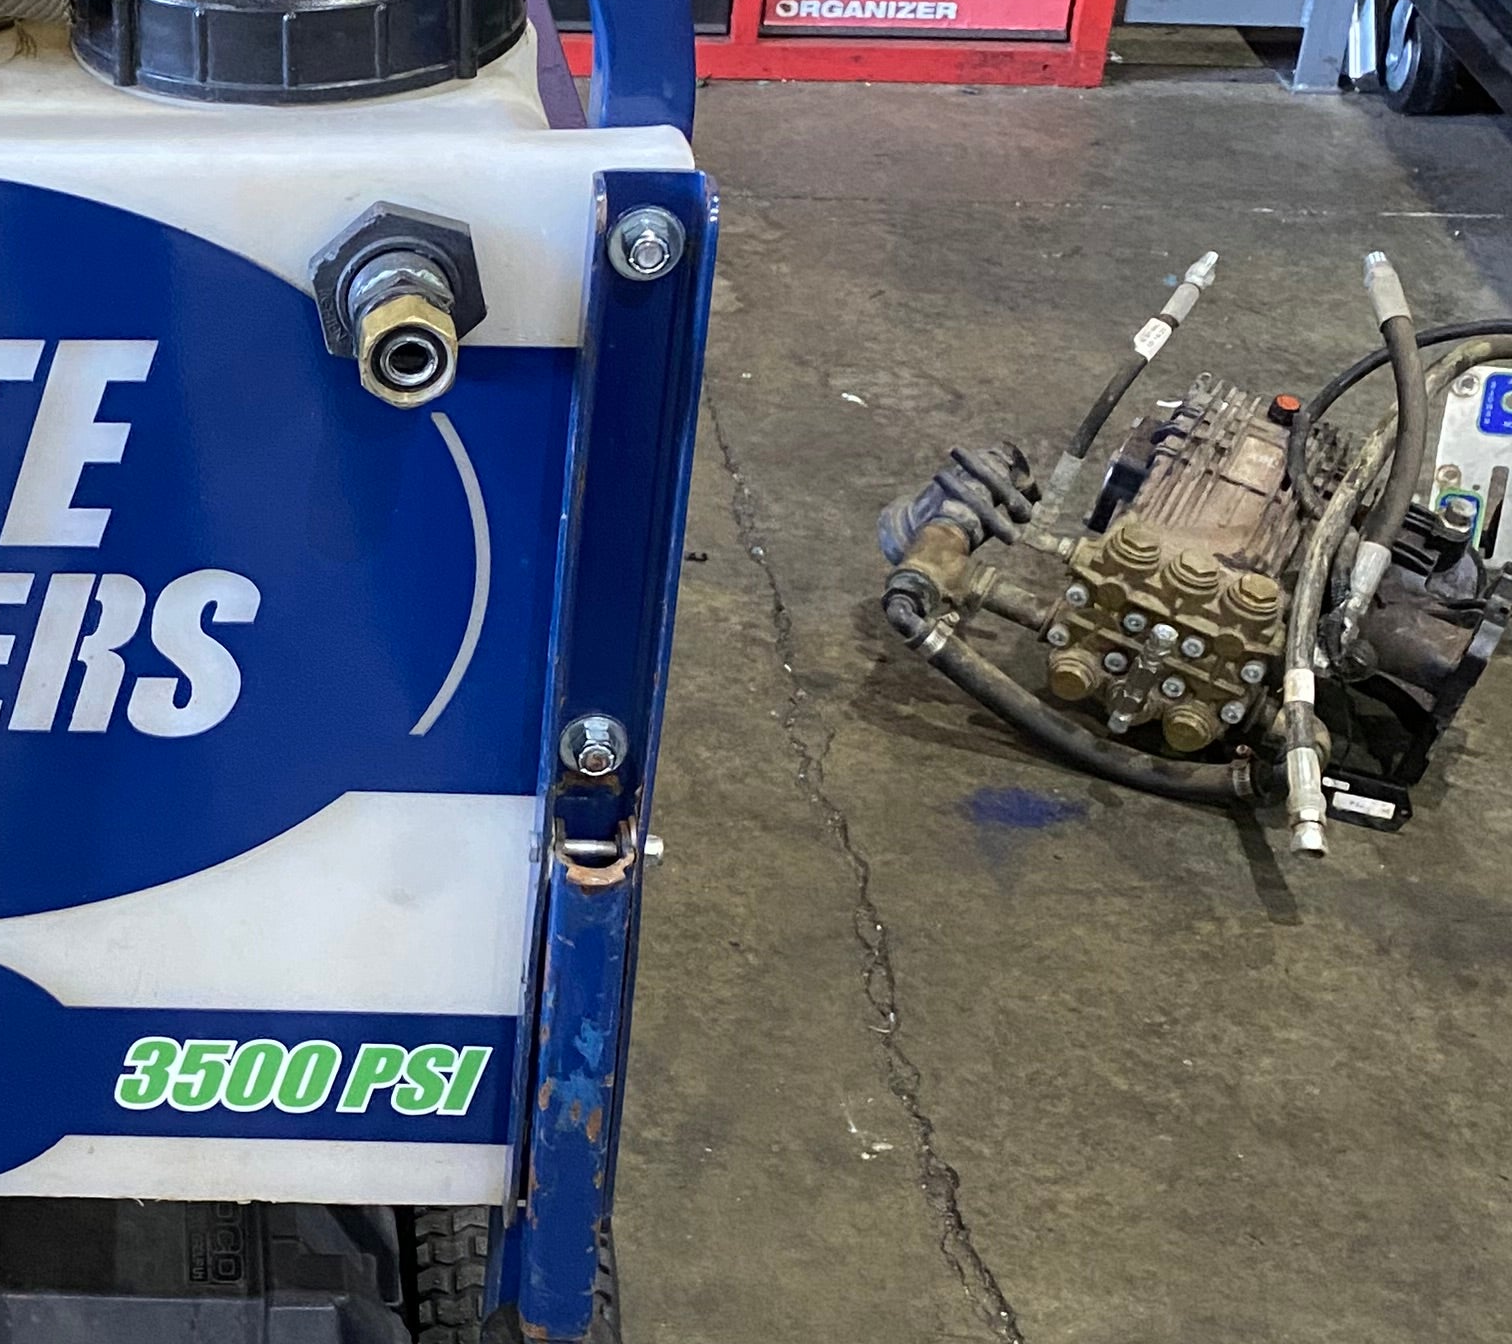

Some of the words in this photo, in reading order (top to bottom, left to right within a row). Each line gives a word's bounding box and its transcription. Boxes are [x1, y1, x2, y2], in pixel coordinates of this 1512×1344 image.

[775, 0, 958, 20] ORGANIZER
[114, 1036, 342, 1114] 3500
[336, 1043, 493, 1116] PSI
